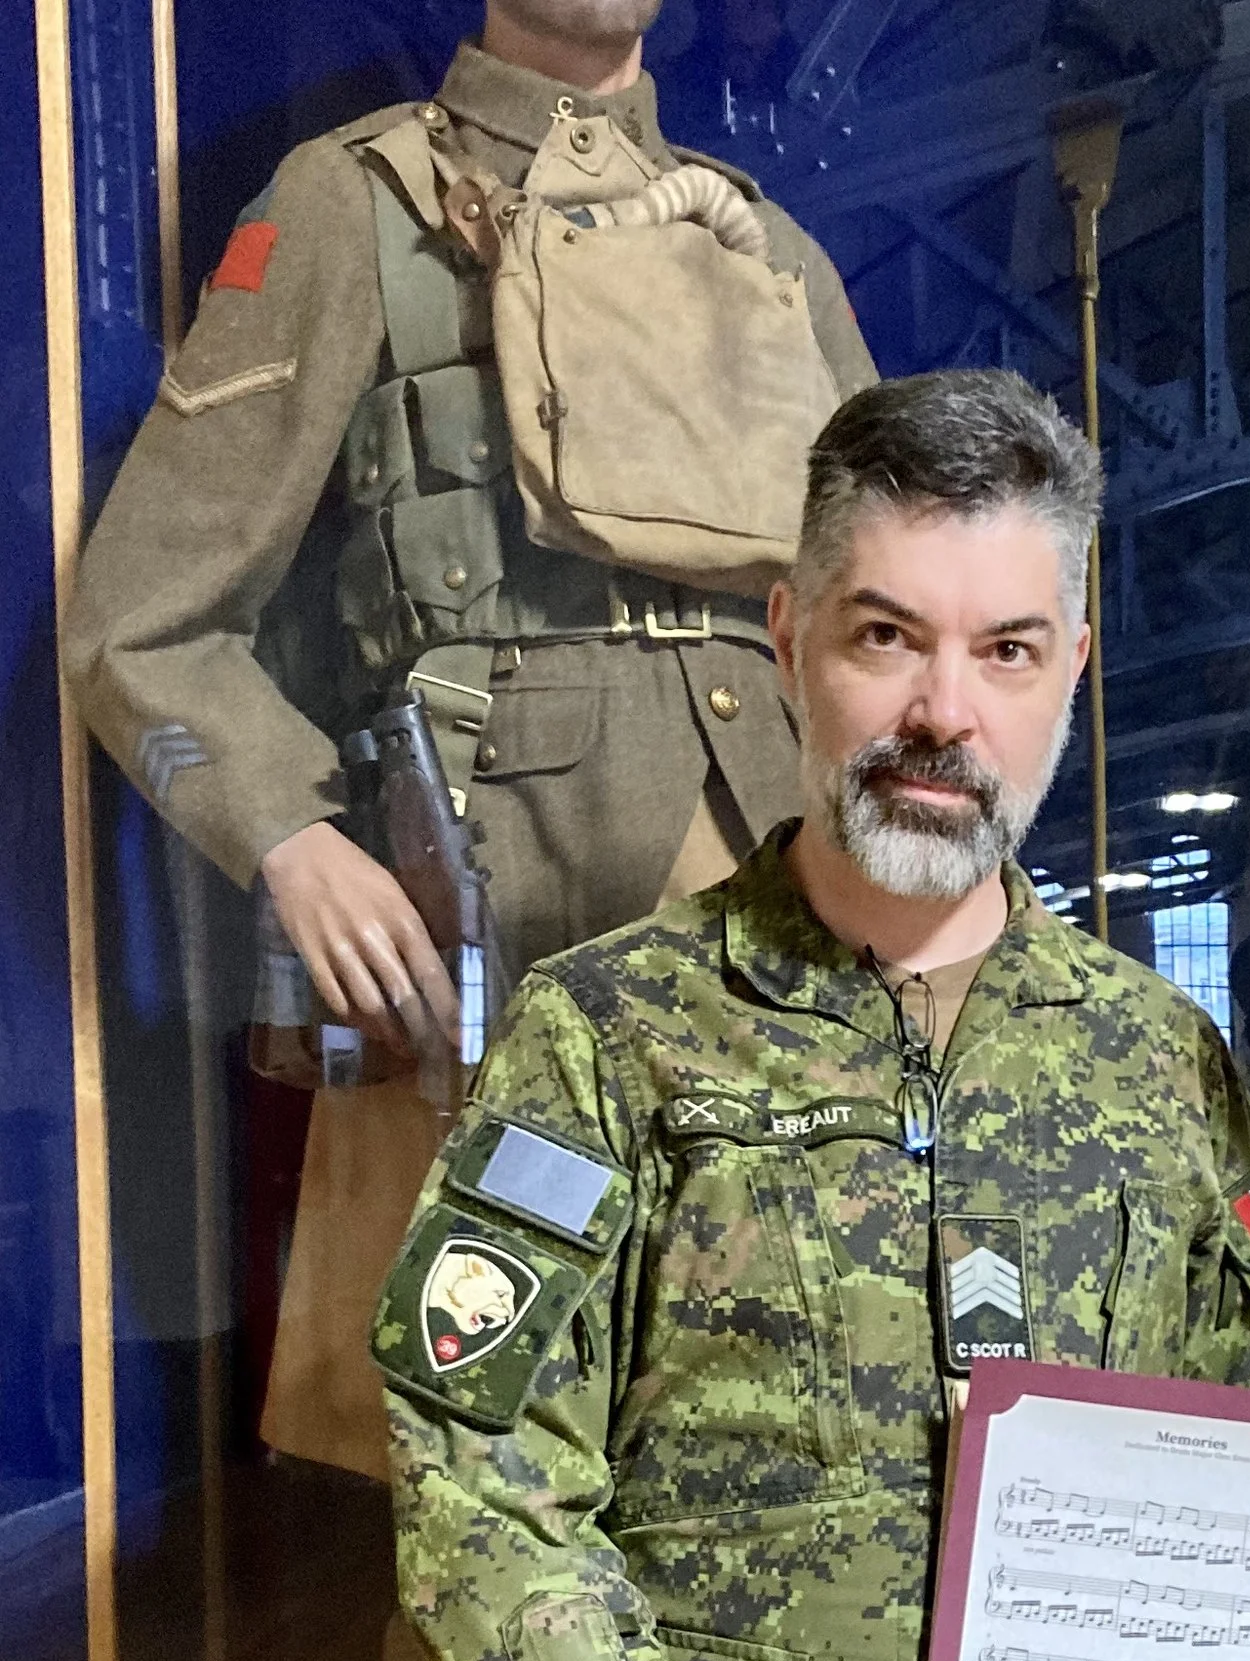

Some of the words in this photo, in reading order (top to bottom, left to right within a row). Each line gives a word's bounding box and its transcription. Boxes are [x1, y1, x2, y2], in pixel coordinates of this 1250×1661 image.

[772, 1105, 853, 1138] EREAUT
[437, 1339, 459, 1356] 39
[955, 1343, 969, 1358] C
[970, 1343, 1012, 1359] SCOT
[1014, 1343, 1027, 1358] R
[1155, 1430, 1229, 1451] Memories
